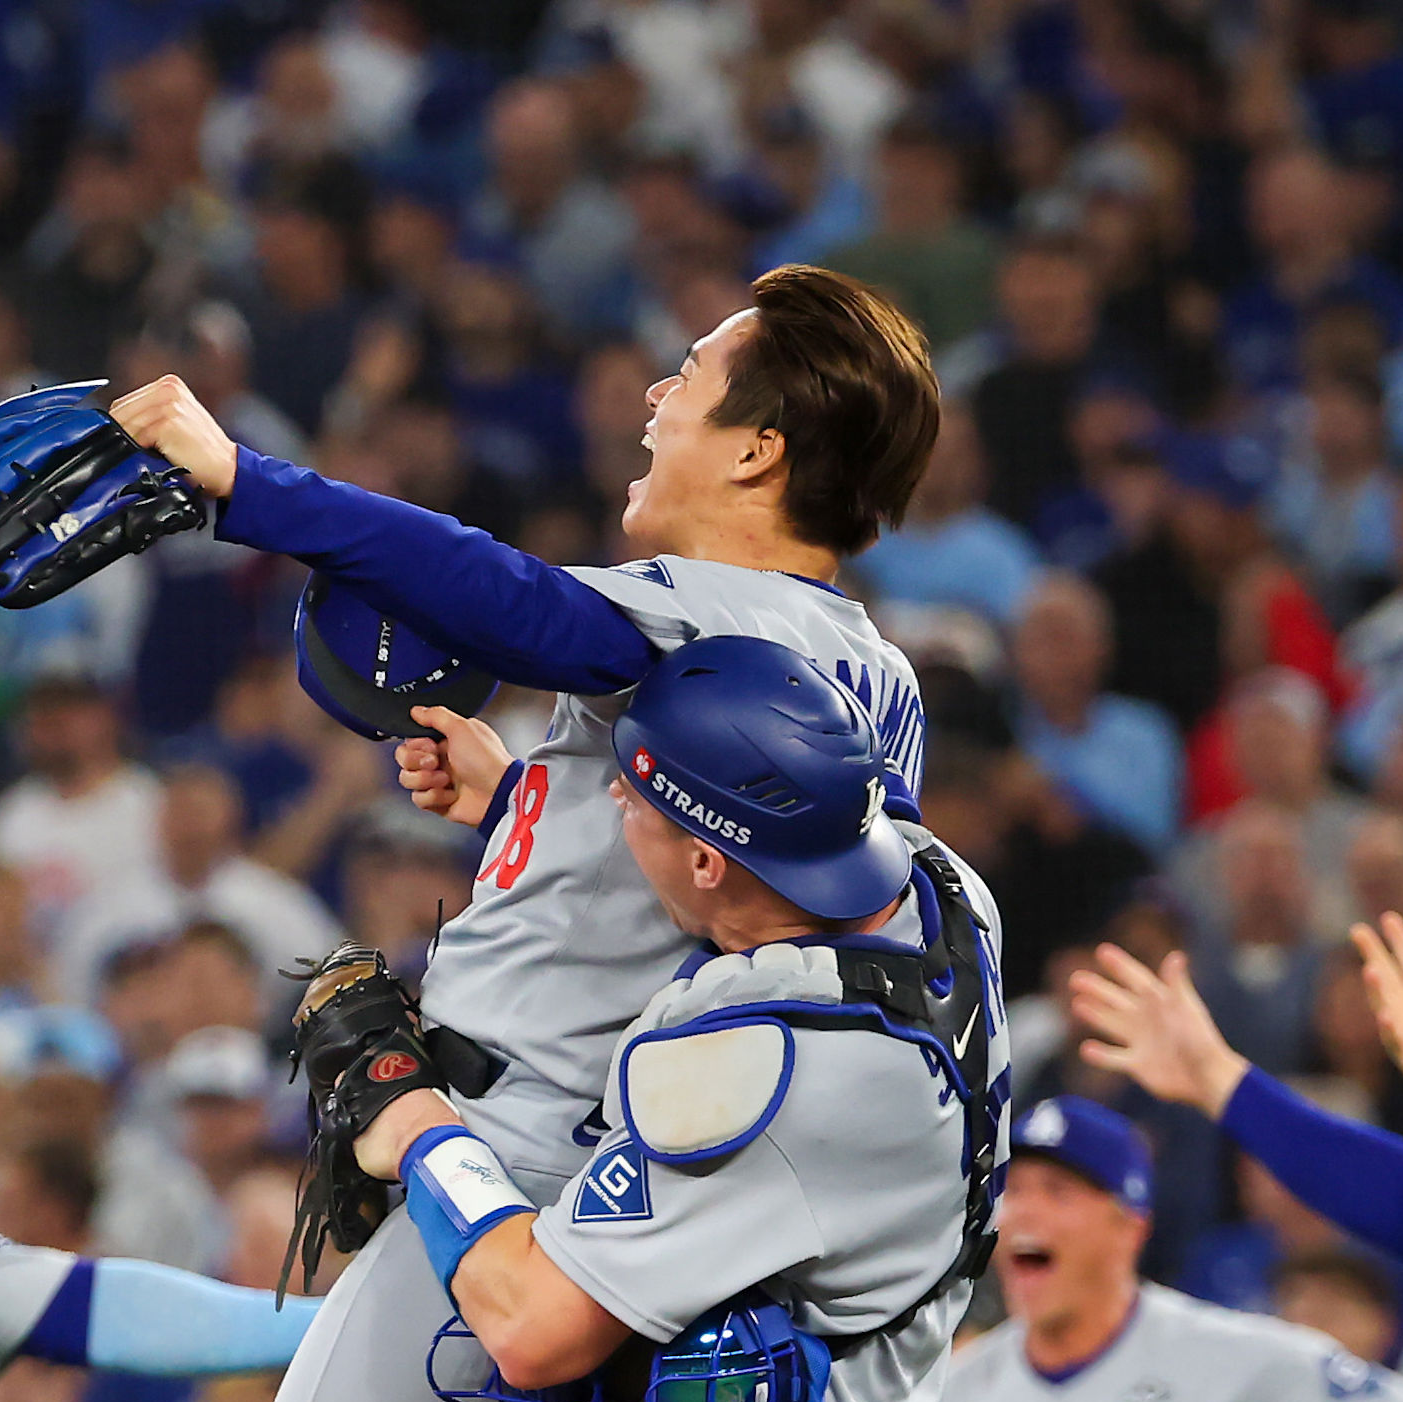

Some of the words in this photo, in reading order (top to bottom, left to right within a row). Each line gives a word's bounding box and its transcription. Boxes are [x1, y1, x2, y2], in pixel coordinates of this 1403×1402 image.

[49, 512, 80, 542] 18
[651, 772, 752, 845] STRAUSS
[599, 1154, 639, 1198] G
